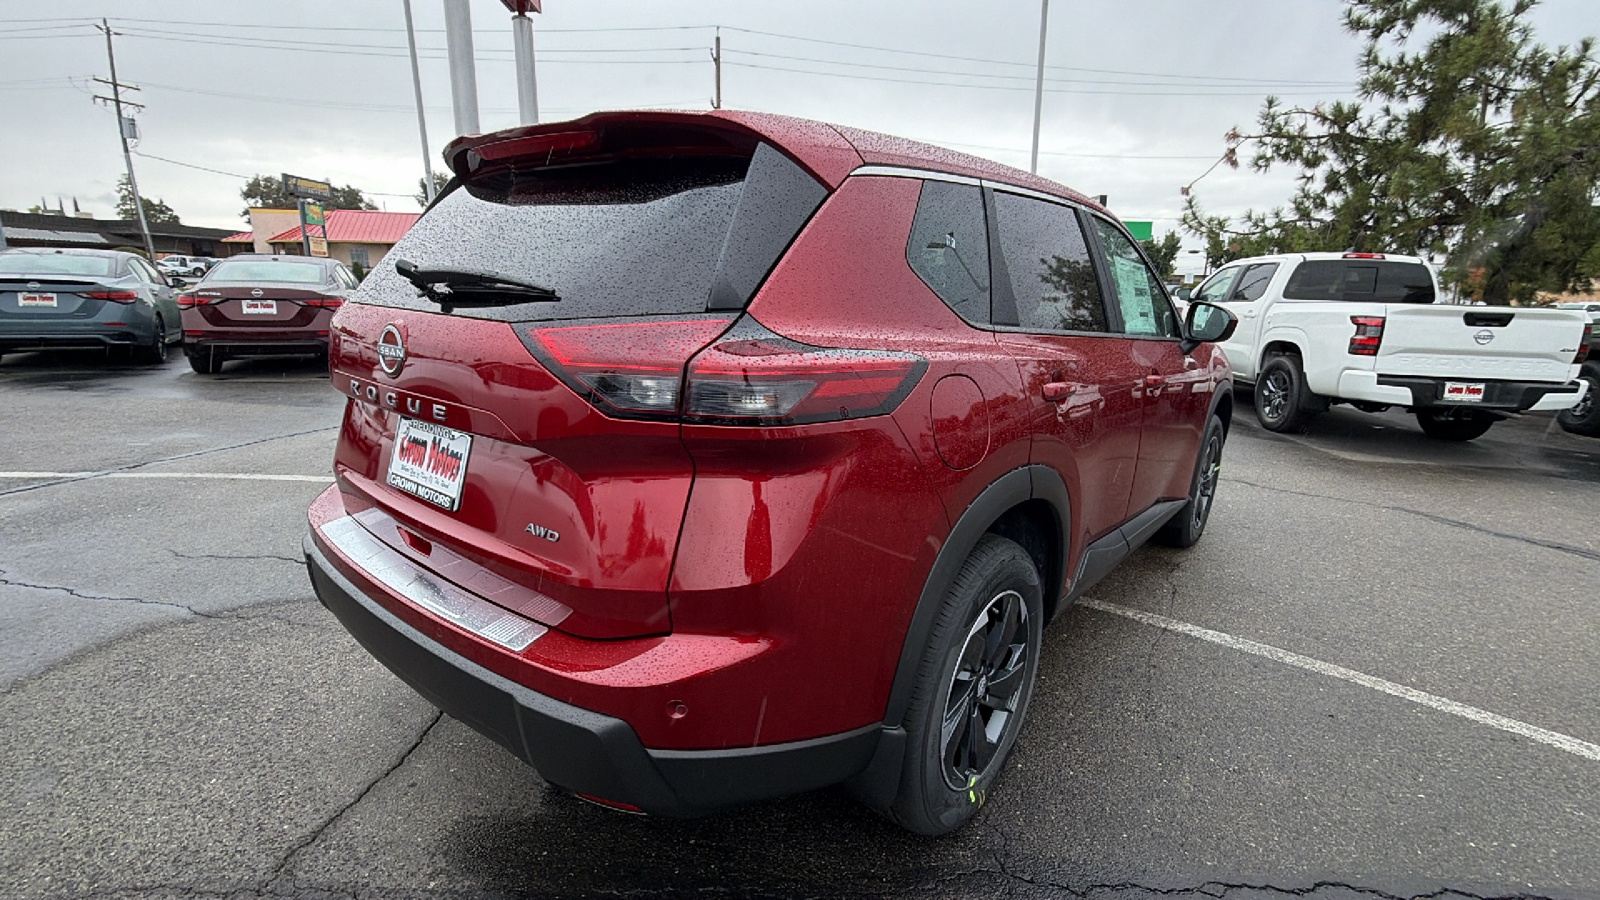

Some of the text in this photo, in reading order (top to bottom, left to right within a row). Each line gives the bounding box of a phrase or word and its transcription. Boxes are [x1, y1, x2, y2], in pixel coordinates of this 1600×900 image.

[1399, 357, 1553, 372] FRONTIER
[350, 379, 447, 421] ROGUE
[398, 430, 428, 469] Crown
[426, 436, 464, 482] Motors
[390, 474, 451, 507] CROWN MOTORS
[524, 521, 560, 543] AWD
